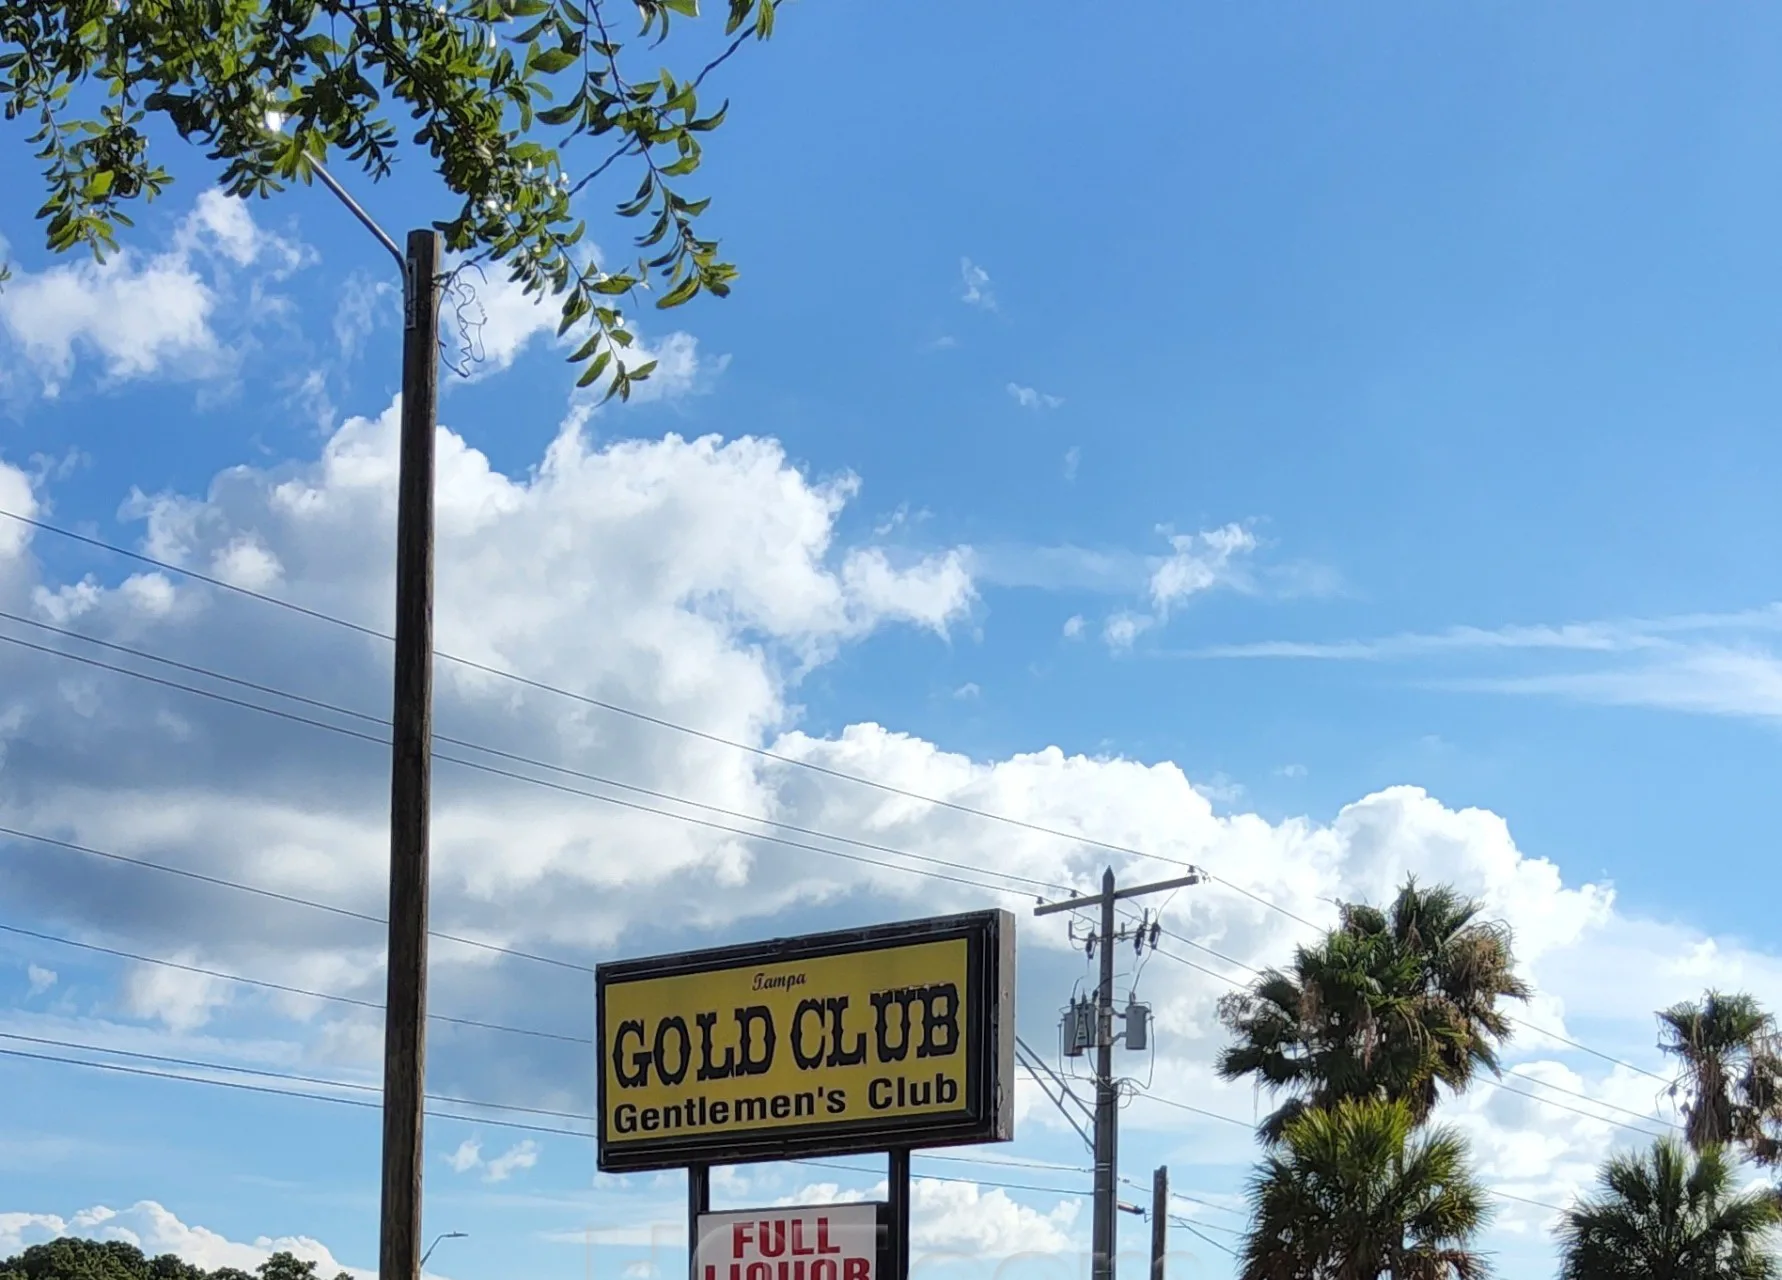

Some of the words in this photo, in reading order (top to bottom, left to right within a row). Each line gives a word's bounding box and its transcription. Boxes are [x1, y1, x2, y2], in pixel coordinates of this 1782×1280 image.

[751, 971, 807, 992] Tampa
[612, 1005, 777, 1088] GOLD
[790, 982, 960, 1070] CLUB
[614, 1087, 847, 1134] Gentlemen's
[868, 1073, 959, 1110] Club
[733, 1217, 841, 1259] FULL
